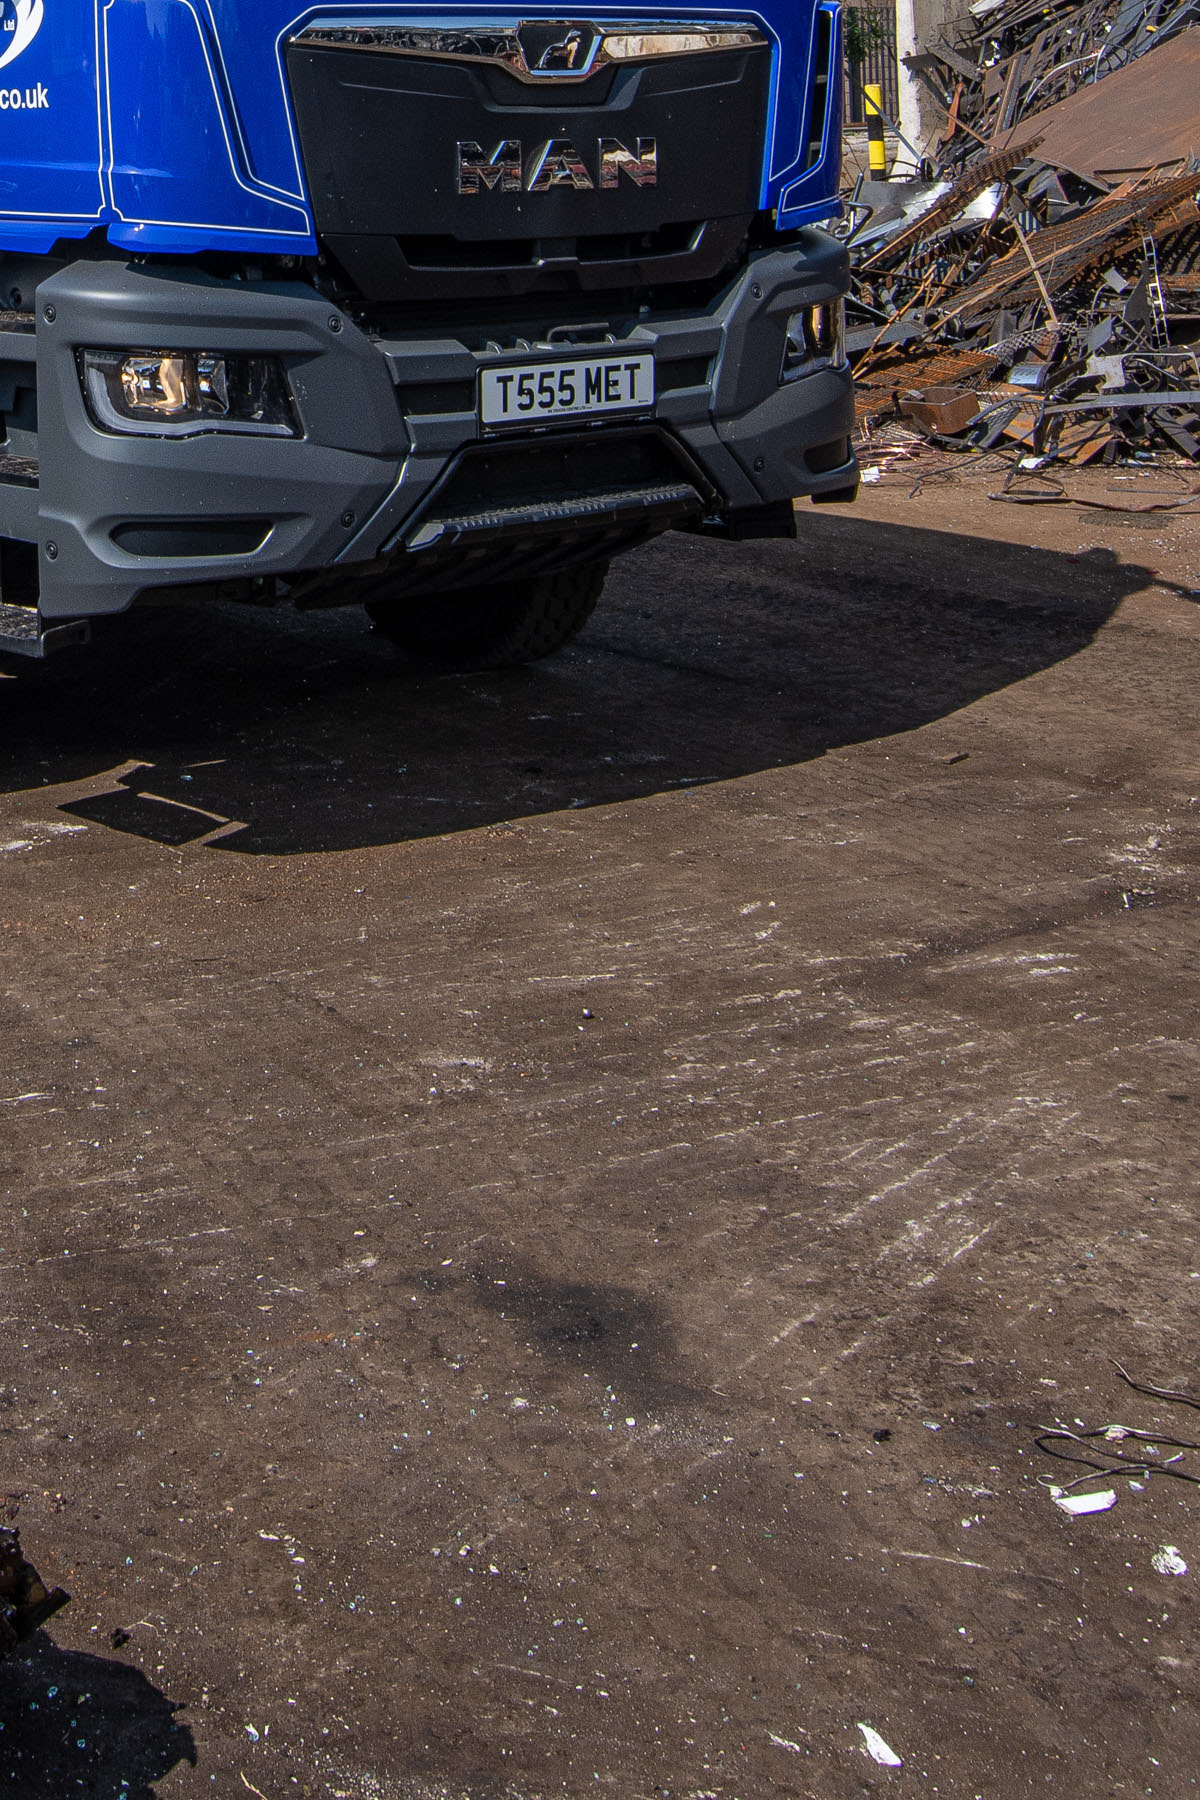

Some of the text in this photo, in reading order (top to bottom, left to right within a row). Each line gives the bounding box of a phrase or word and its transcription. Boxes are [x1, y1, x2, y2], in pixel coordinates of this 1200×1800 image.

[456, 137, 657, 194] MAN
[496, 363, 641, 413] T555 MET
